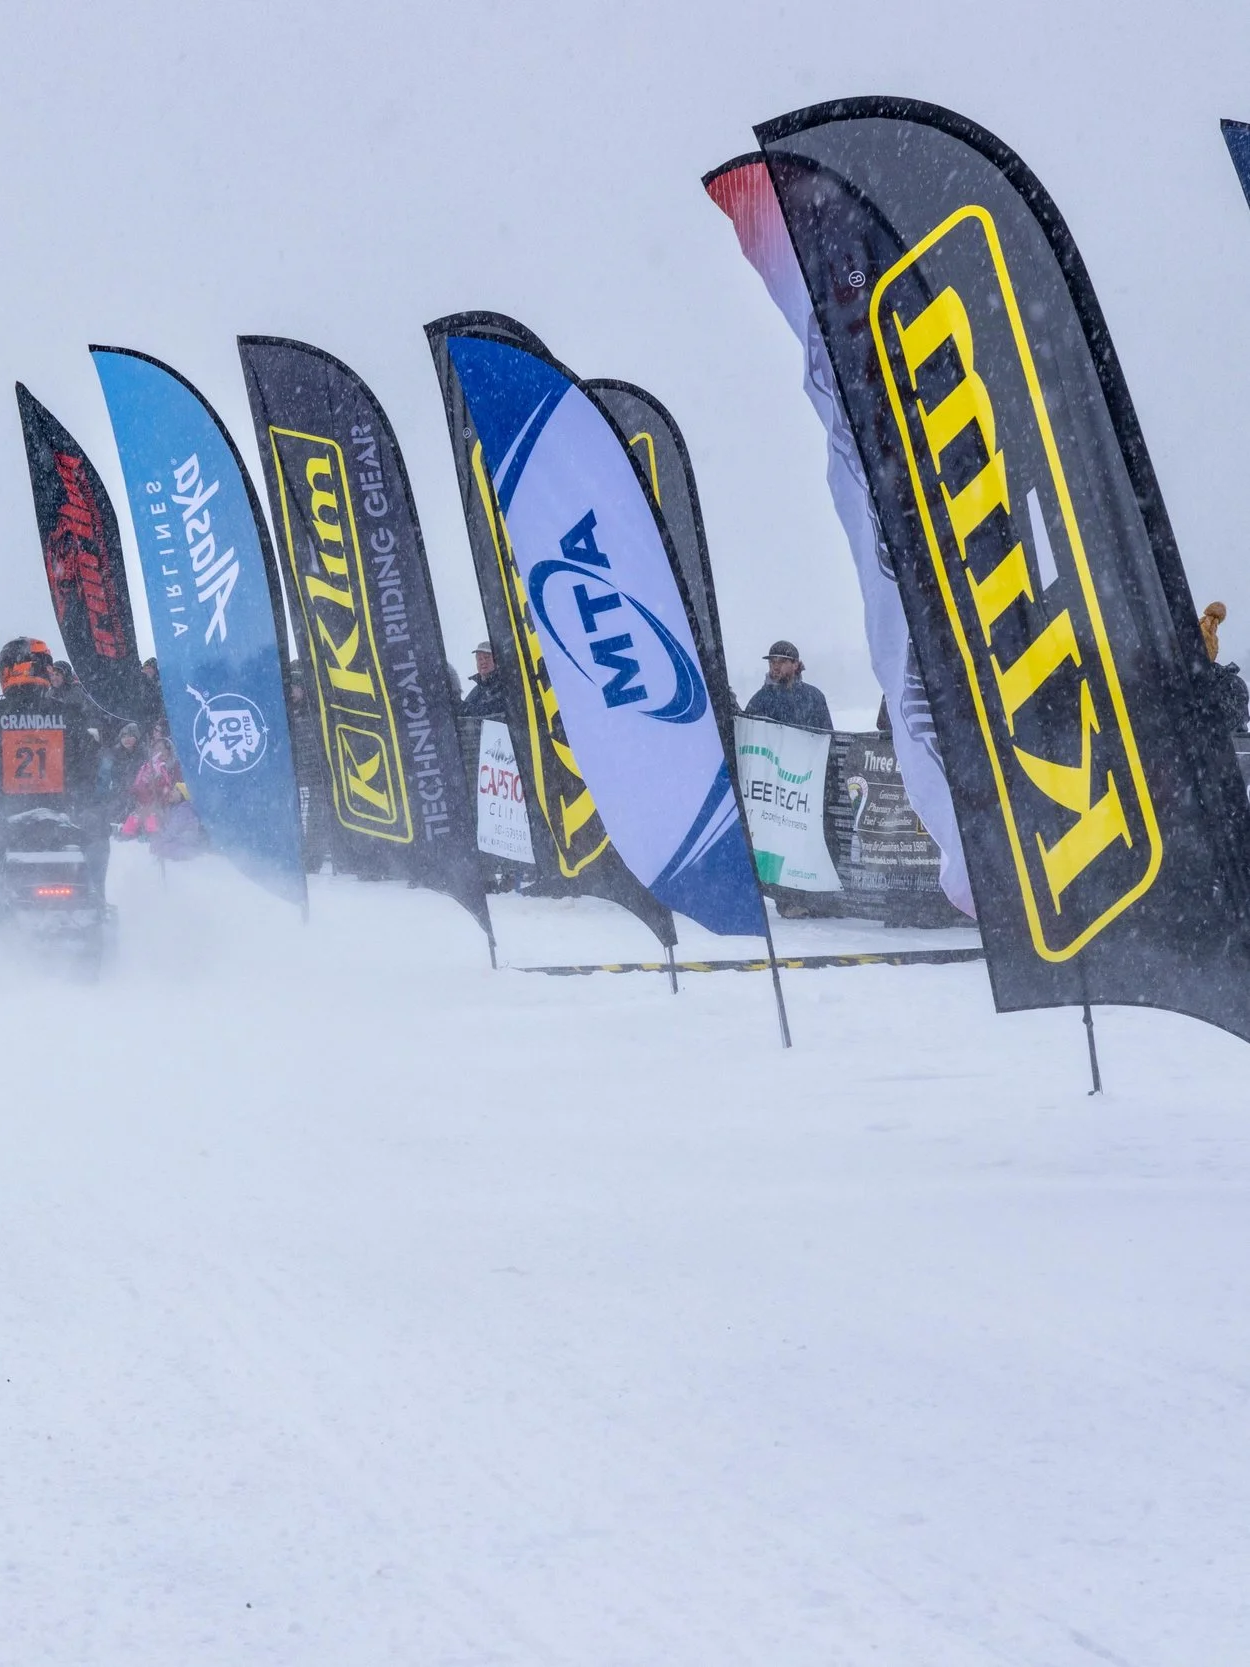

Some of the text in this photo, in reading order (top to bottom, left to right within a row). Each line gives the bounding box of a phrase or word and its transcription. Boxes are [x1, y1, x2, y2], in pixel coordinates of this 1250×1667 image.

[558, 508, 649, 710] MTA
[352, 423, 450, 842] TECHNICAL RIDING GEAR
[0, 714, 67, 730] CRANDALL
[14, 746, 47, 779] 21
[864, 750, 893, 772] Three
